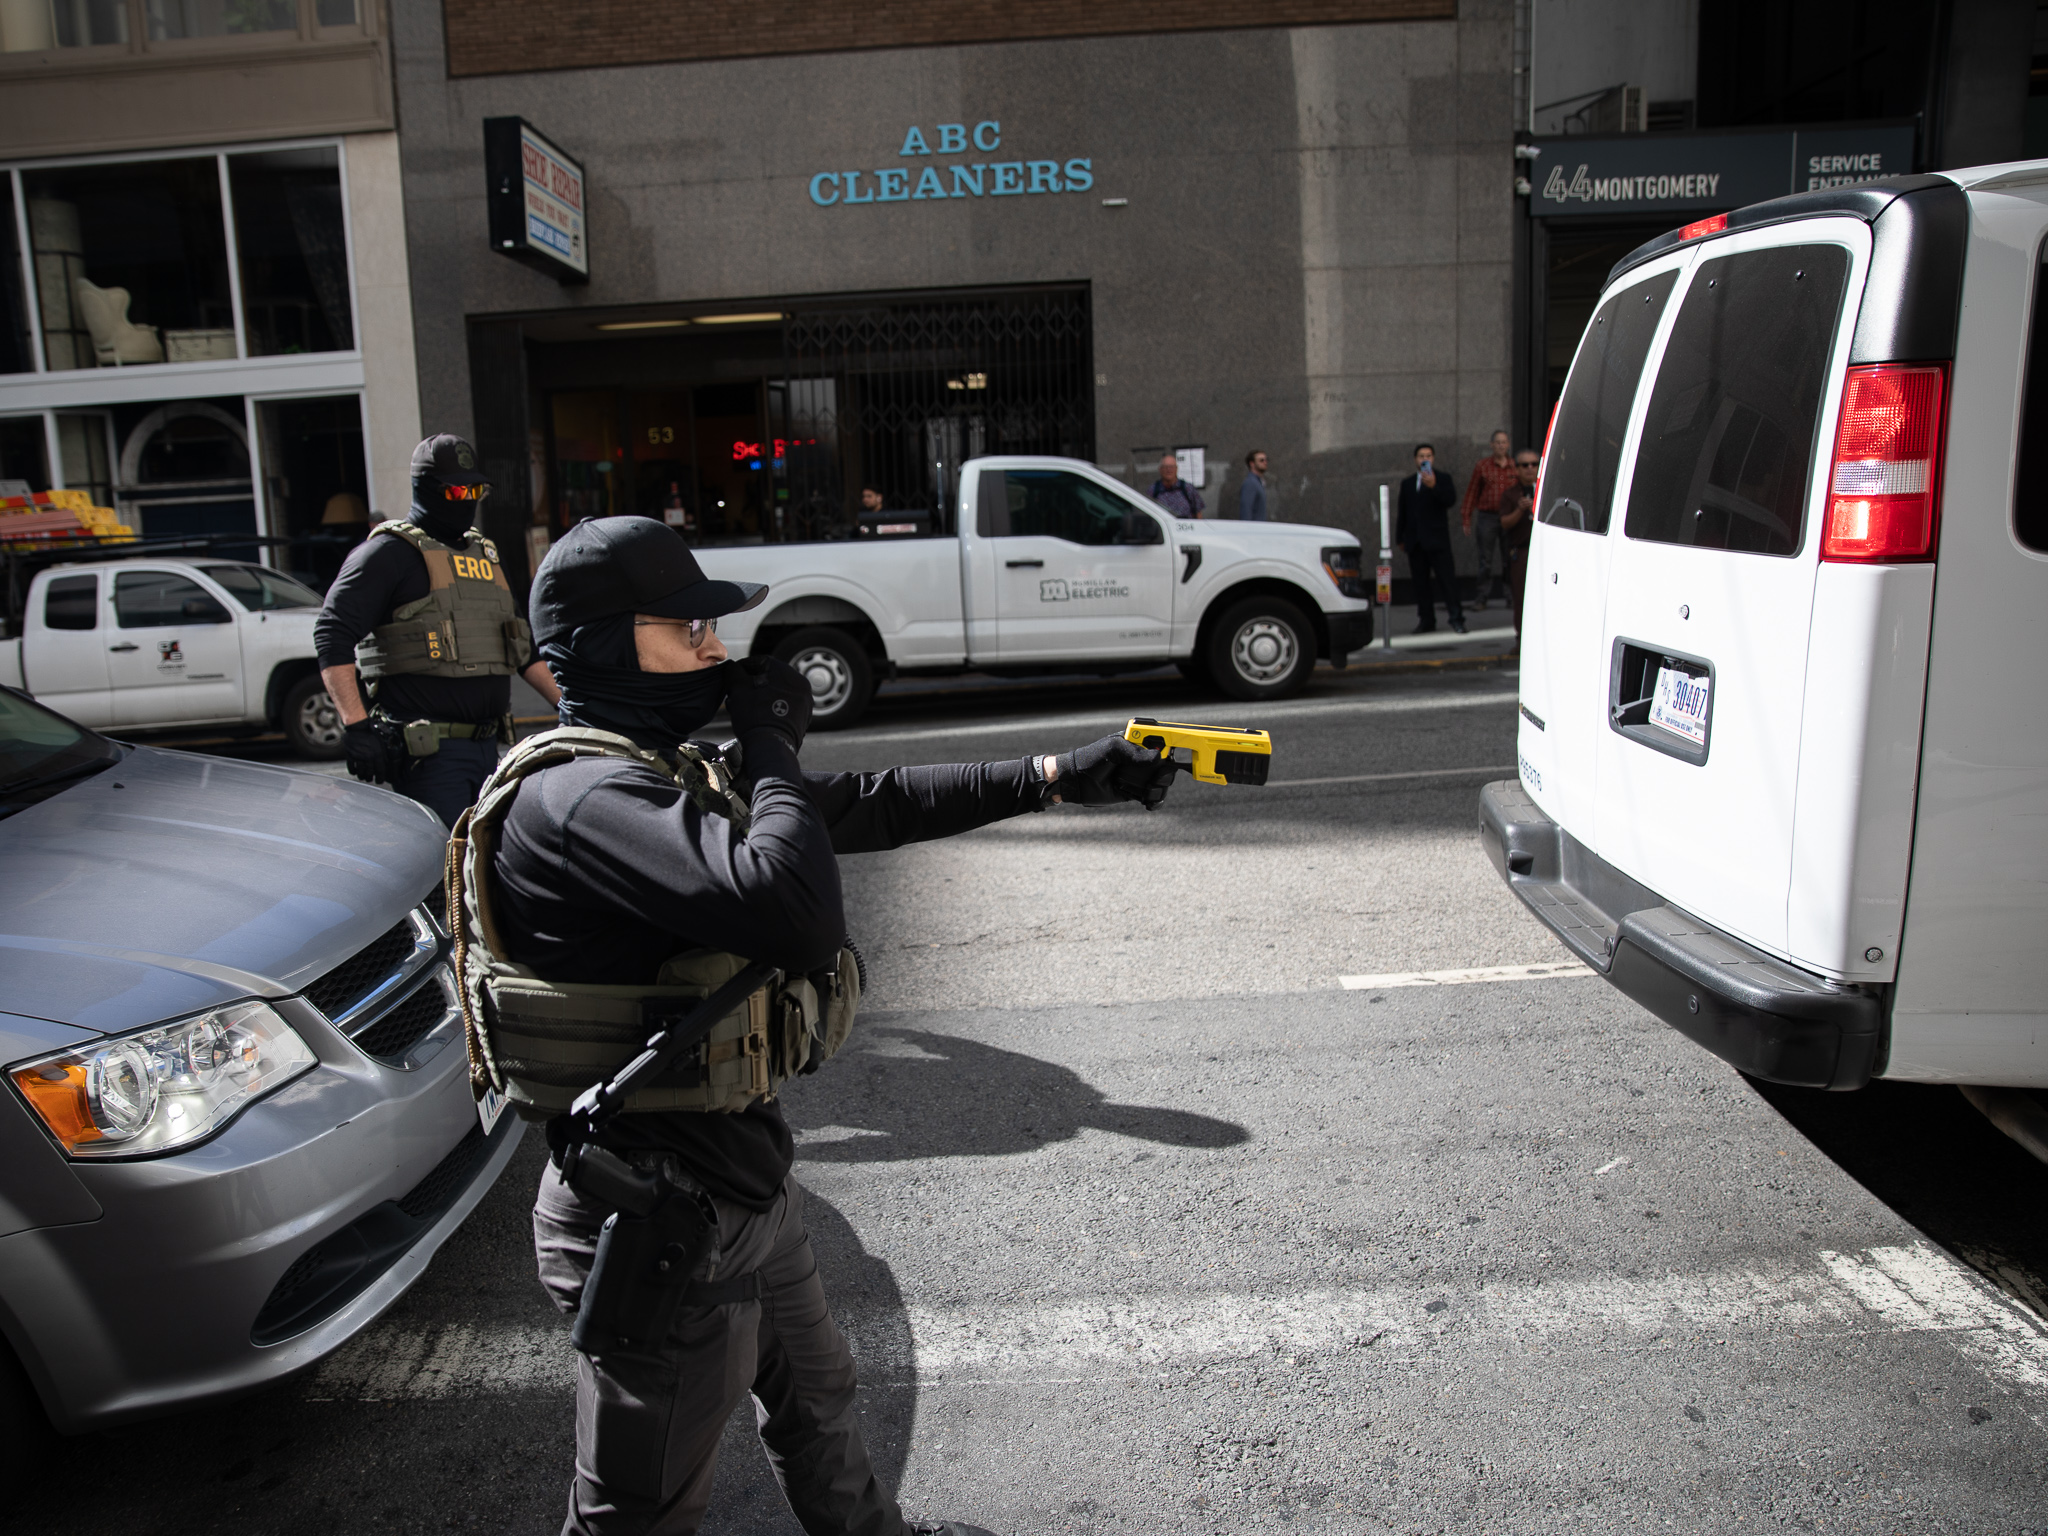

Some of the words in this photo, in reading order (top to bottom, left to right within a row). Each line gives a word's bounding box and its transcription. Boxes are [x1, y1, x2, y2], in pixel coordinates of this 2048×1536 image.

[899, 121, 1001, 156] ABC
[522, 143, 548, 188] SHOE
[550, 162, 581, 210] REPAIR
[1808, 153, 1882, 174] SERVICE
[809, 158, 1093, 206] CLEANERS
[1542, 164, 1594, 203] 44
[1594, 173, 1721, 202] MONTGOMERY
[647, 426, 675, 445] 53
[1175, 522, 1195, 533] 304
[453, 555, 494, 581] ERO
[1071, 586, 1129, 599] ELECTRIC
[428, 631, 441, 659] ERO
[1672, 680, 1707, 721] 30407
